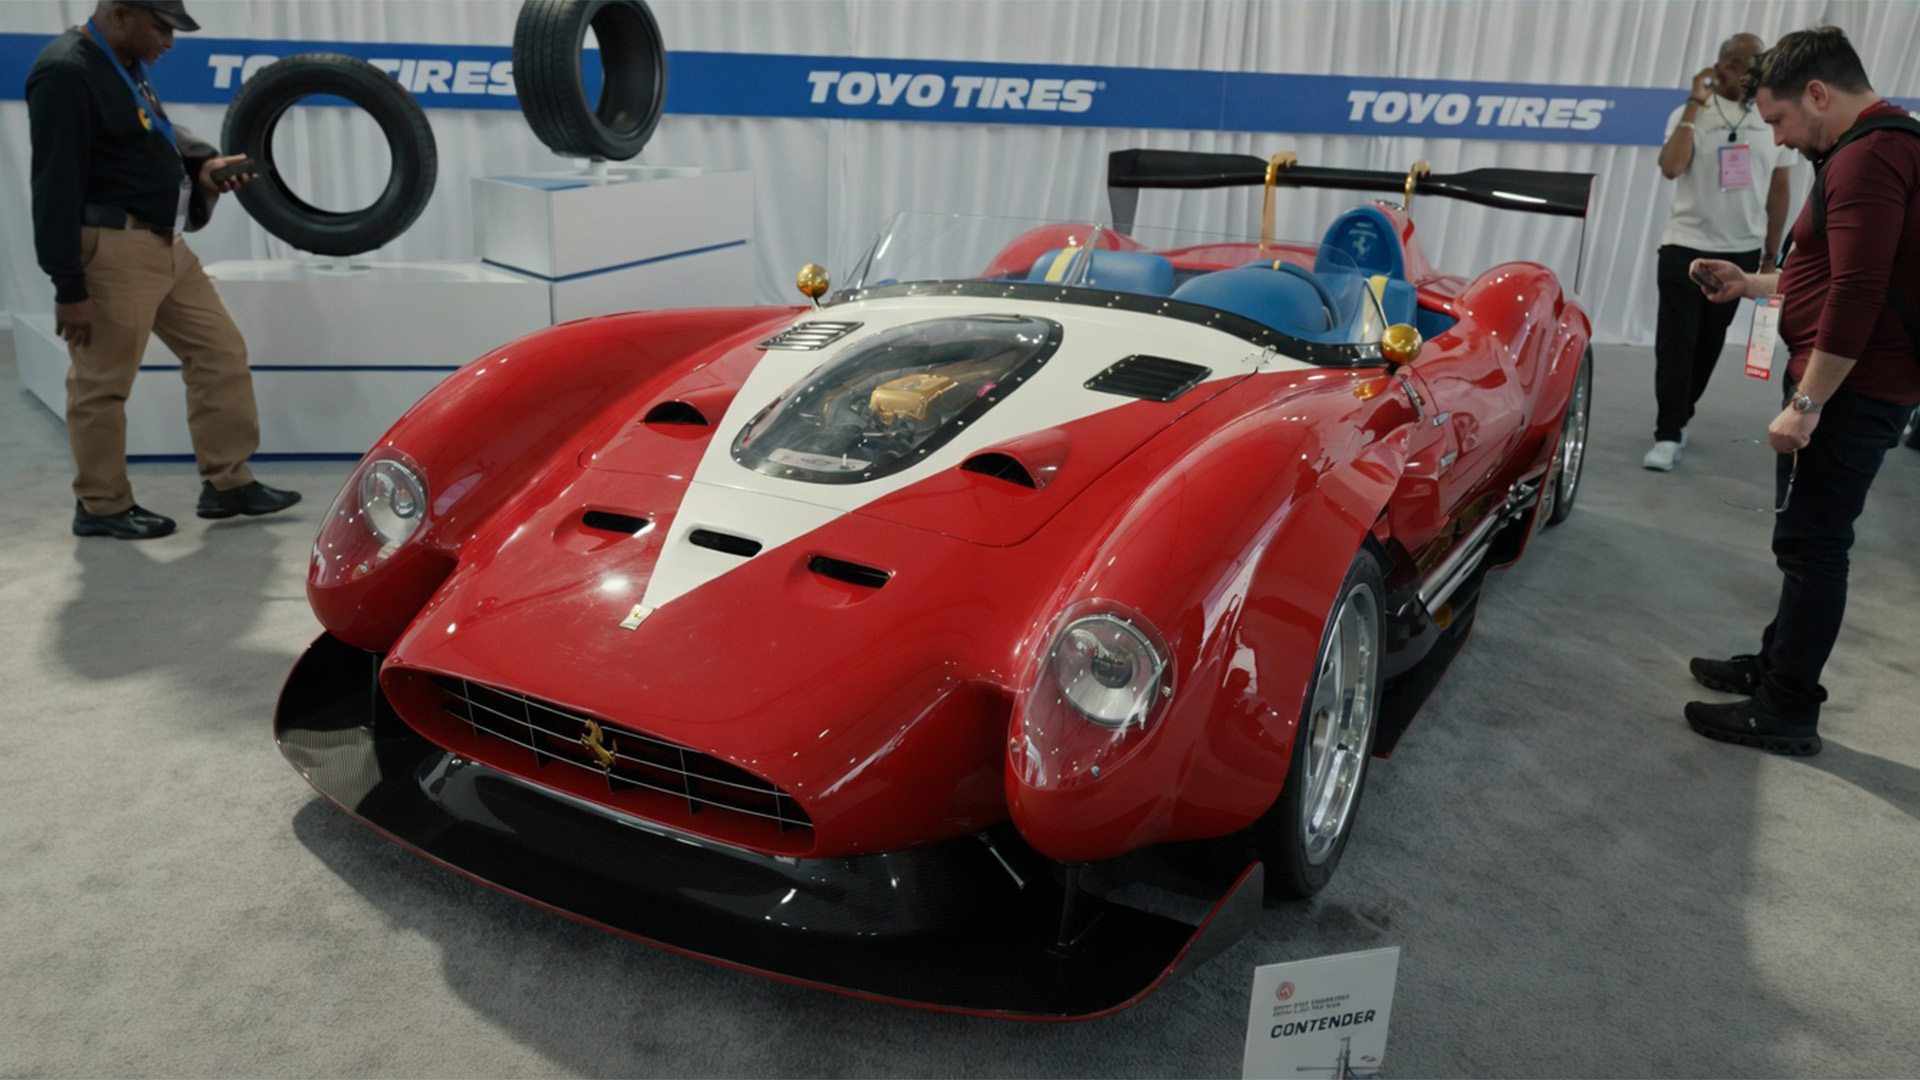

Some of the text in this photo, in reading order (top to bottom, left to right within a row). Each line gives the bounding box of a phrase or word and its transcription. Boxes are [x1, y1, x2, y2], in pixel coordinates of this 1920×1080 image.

[807, 70, 1097, 113] TOYO TIRES
[1348, 90, 1607, 130] TOYO TIRES
[1271, 1009, 1376, 1039] CONTENDER
